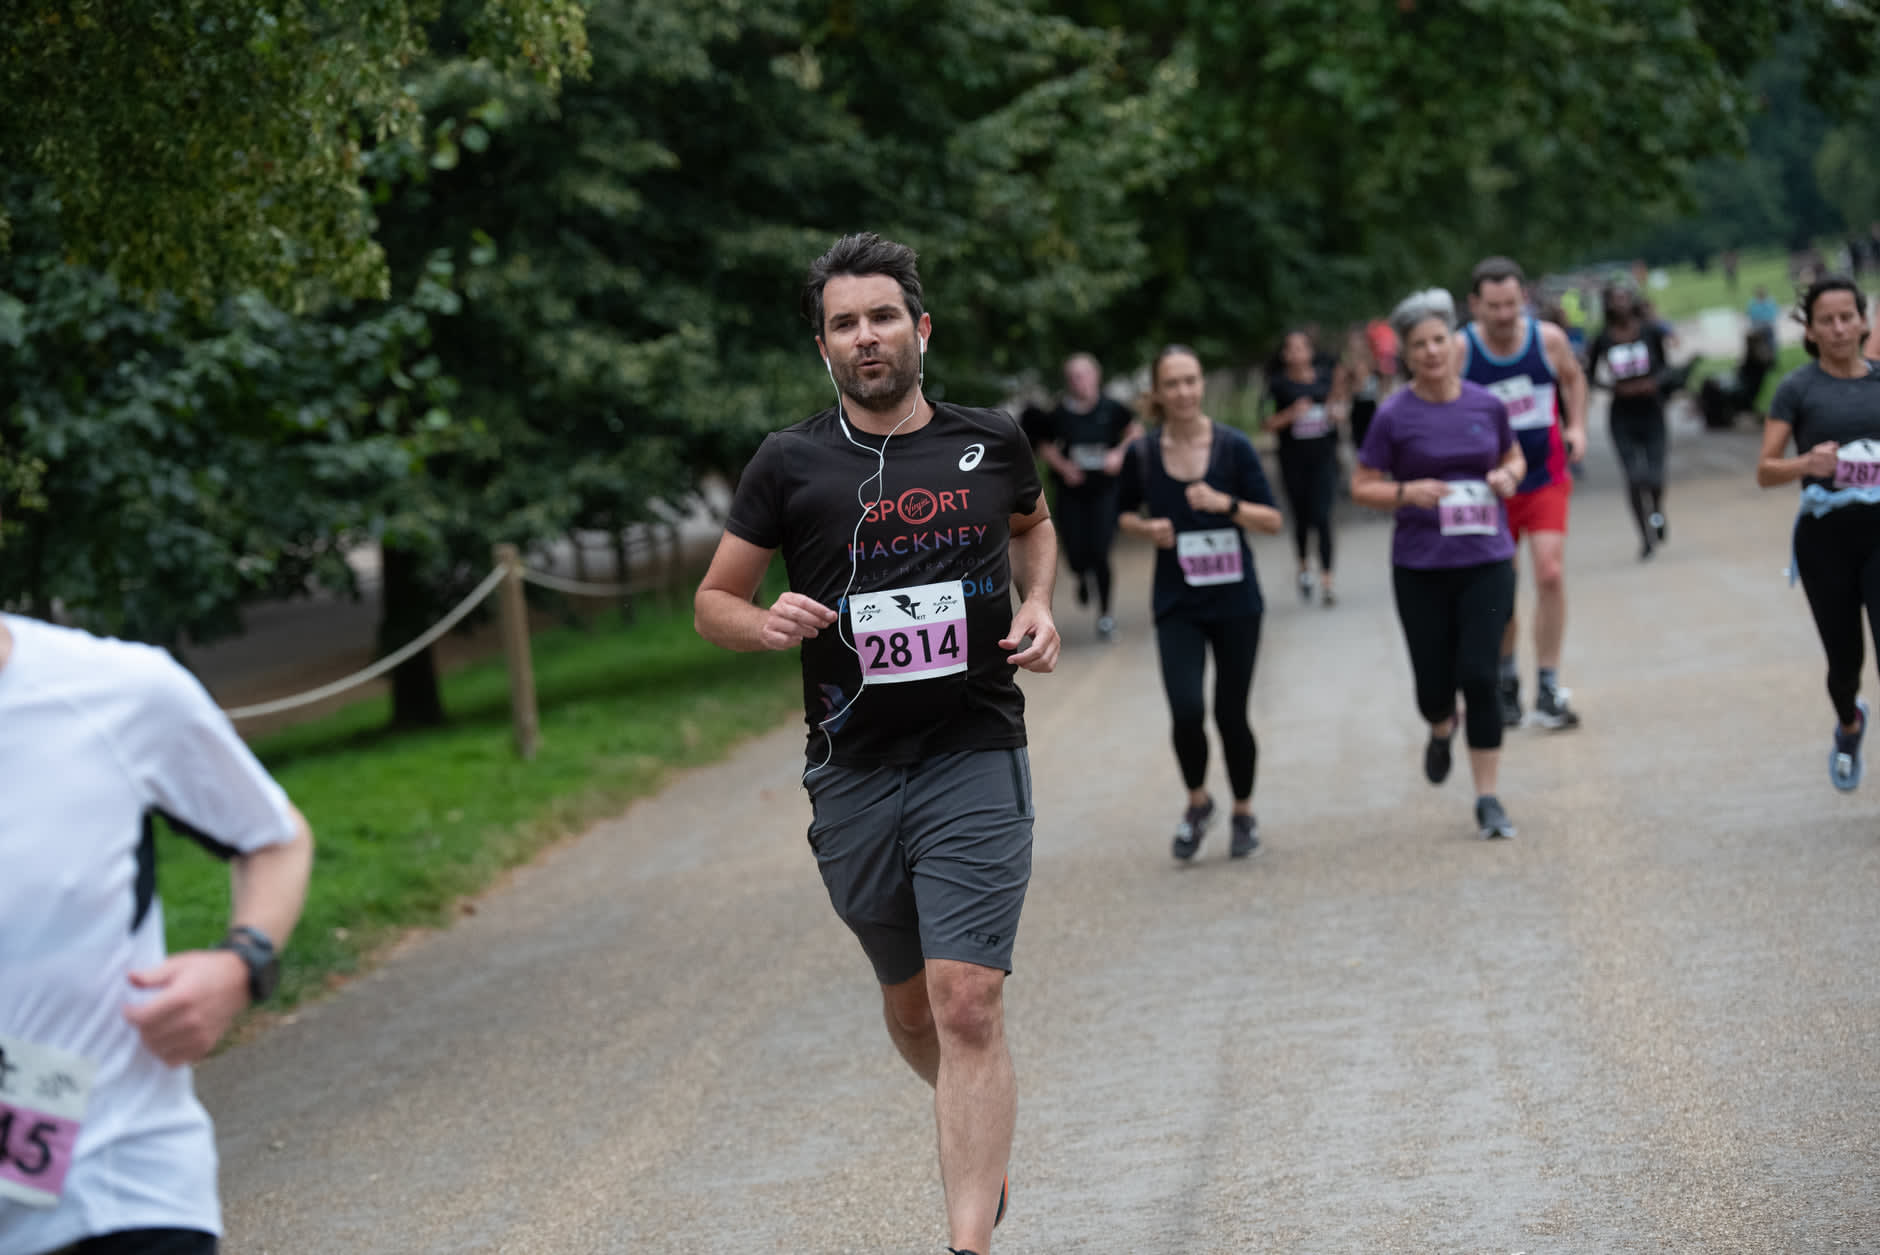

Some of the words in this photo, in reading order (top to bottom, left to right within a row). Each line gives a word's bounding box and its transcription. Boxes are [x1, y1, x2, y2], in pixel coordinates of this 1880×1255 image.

[864, 487, 971, 525] SPORT
[847, 525, 988, 561] HACKNEY
[865, 623, 960, 669] 2814
